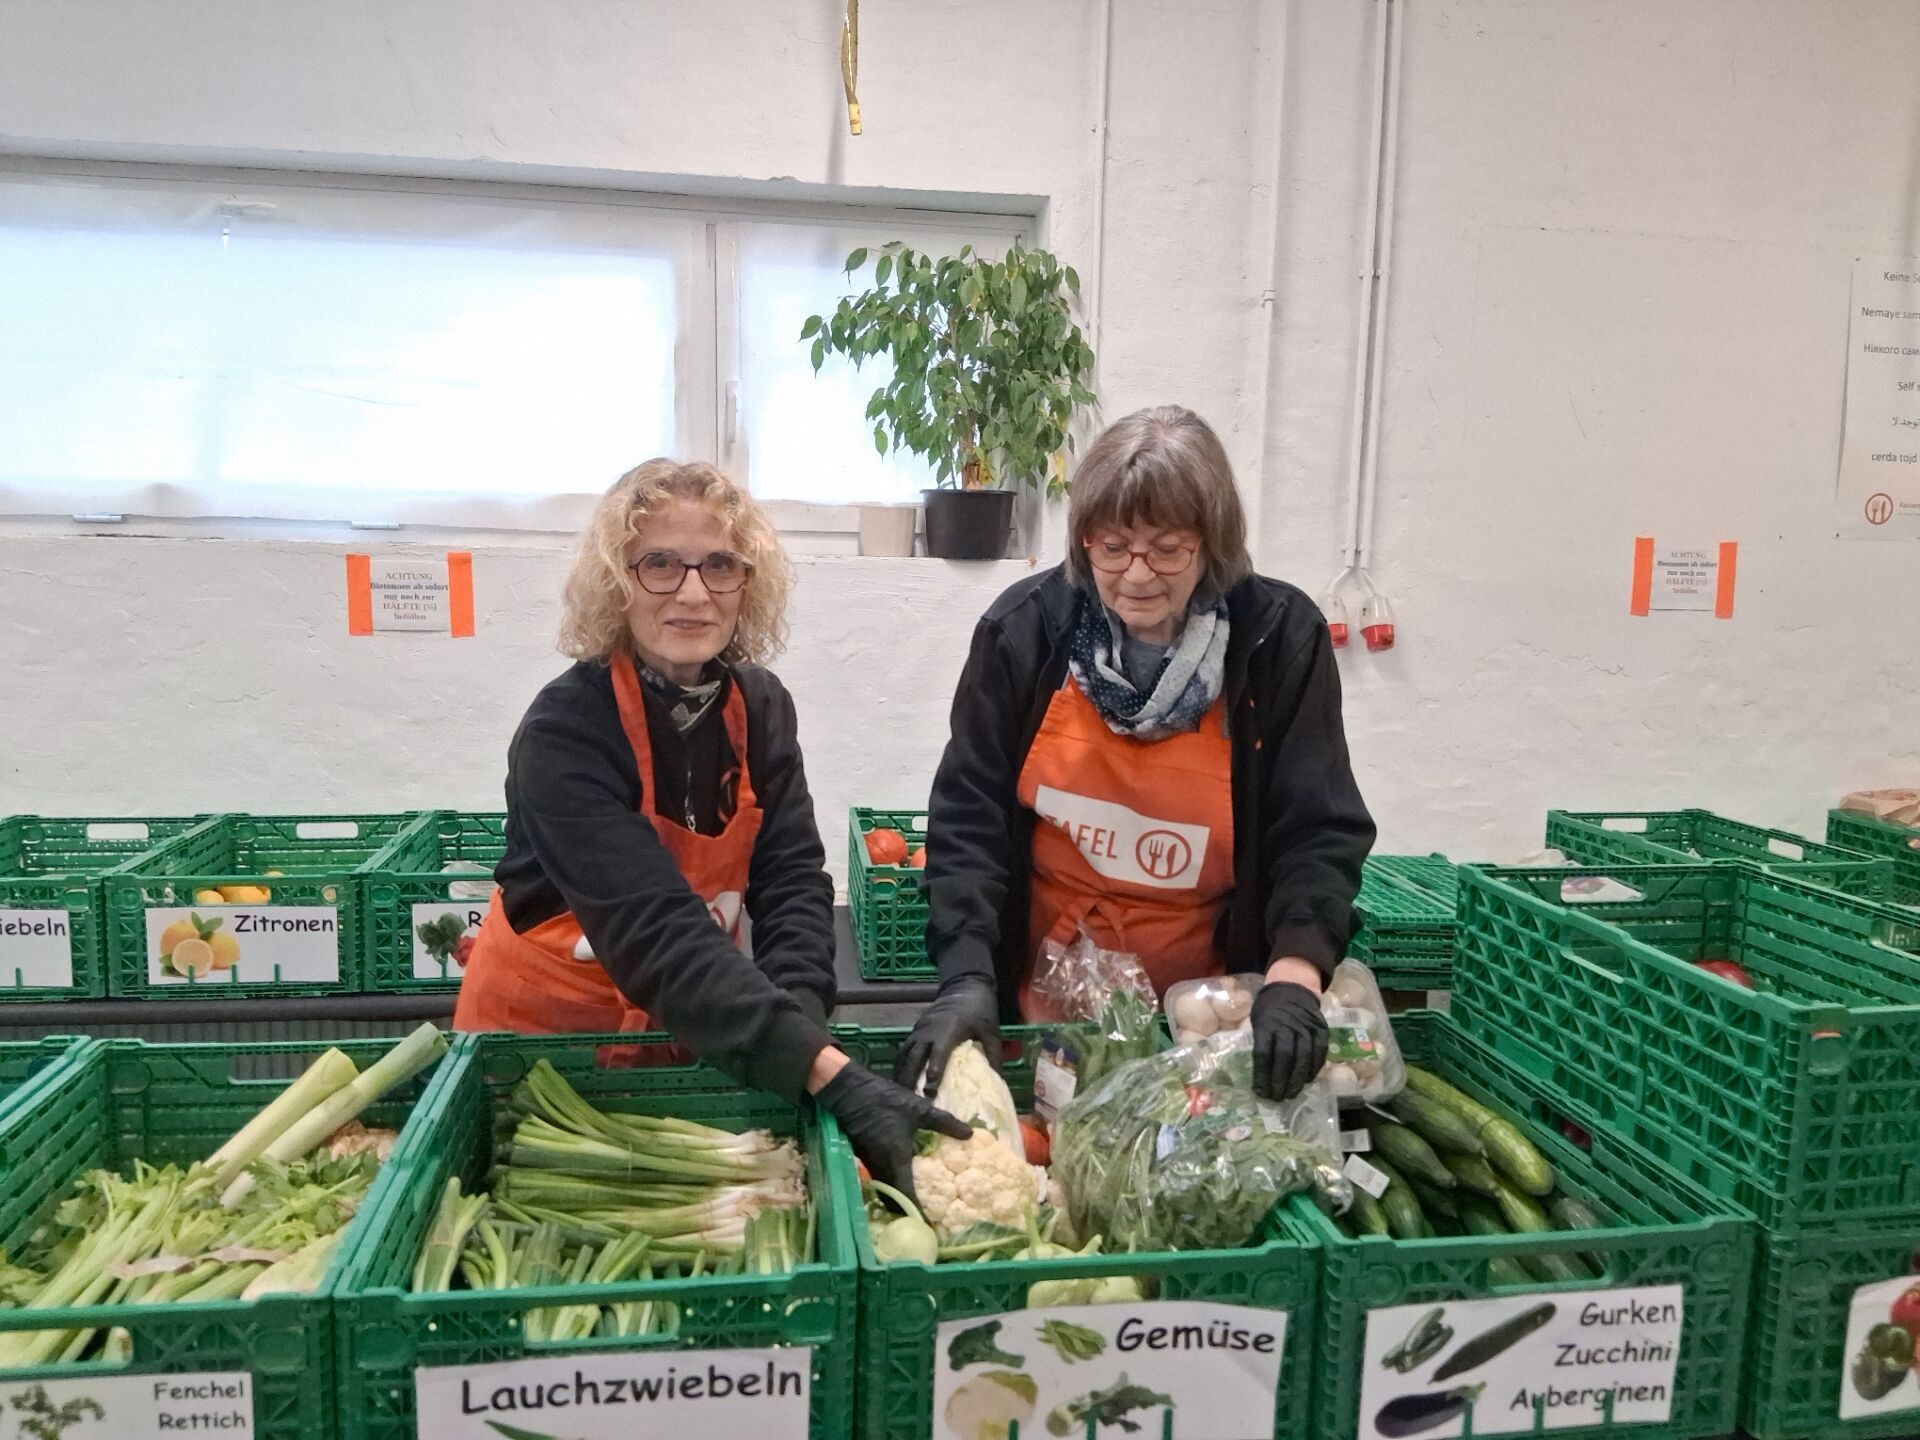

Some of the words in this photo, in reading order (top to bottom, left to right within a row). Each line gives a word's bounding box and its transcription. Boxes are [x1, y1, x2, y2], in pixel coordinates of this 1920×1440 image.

[1883, 271, 1910, 282] Keine
[1862, 307, 1901, 320] Nemaye
[1897, 381, 1915, 391] Self
[385, 572, 433, 581] ACHTUNG
[235, 913, 334, 933] Zitronen
[1580, 1299, 1676, 1326] Gurken
[1116, 1318, 1275, 1352] Gemüse
[1554, 1341, 1673, 1367] Zucchini
[154, 1380, 244, 1401] Fenchel
[462, 1361, 801, 1414] Lauchzwiebeln
[158, 1411, 246, 1431] Rettich
